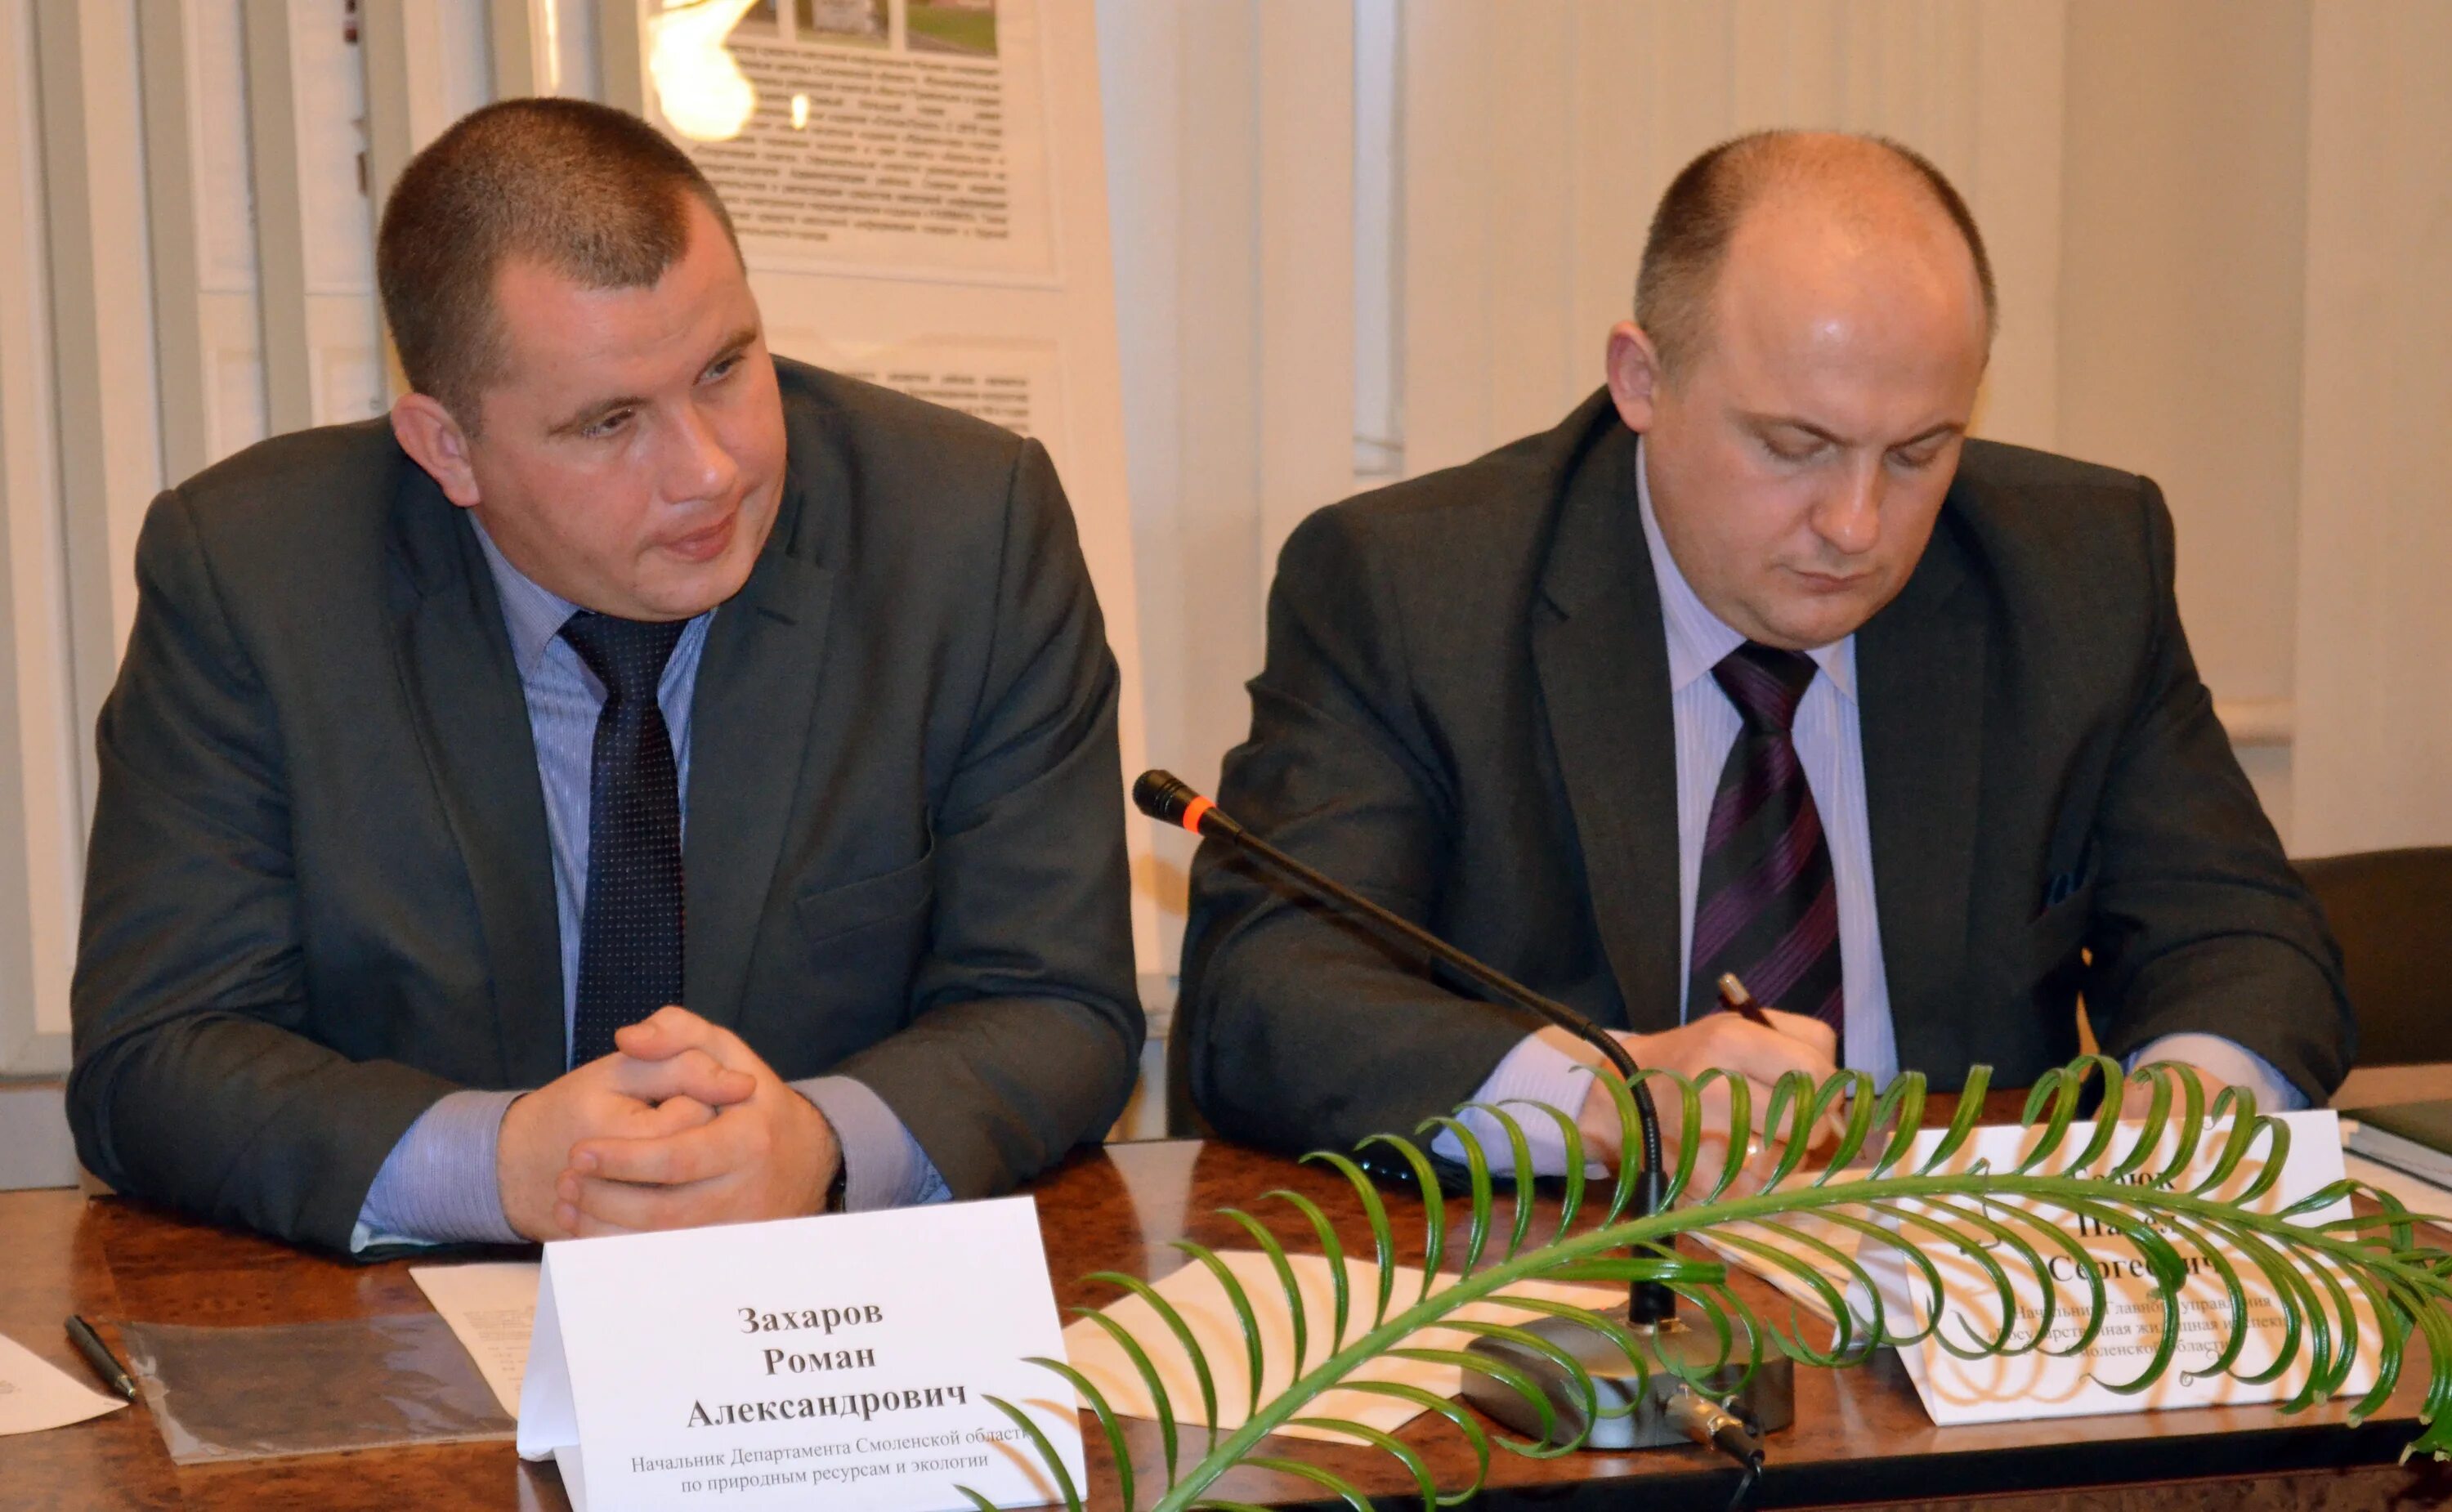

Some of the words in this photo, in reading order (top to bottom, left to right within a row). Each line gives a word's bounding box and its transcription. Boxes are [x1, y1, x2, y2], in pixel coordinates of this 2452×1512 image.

[738, 1303, 884, 1335] Захаров
[762, 1348, 877, 1376] Роман
[687, 1385, 968, 1429] Александрович
[631, 1452, 726, 1473] Начальник
[730, 1443, 851, 1465] Департамента
[856, 1429, 960, 1454] Смоленской
[682, 1481, 702, 1493] по
[708, 1470, 808, 1494] природным
[812, 1461, 890, 1485] ресурсам
[897, 1462, 906, 1474] и
[911, 1454, 989, 1473] экологии
